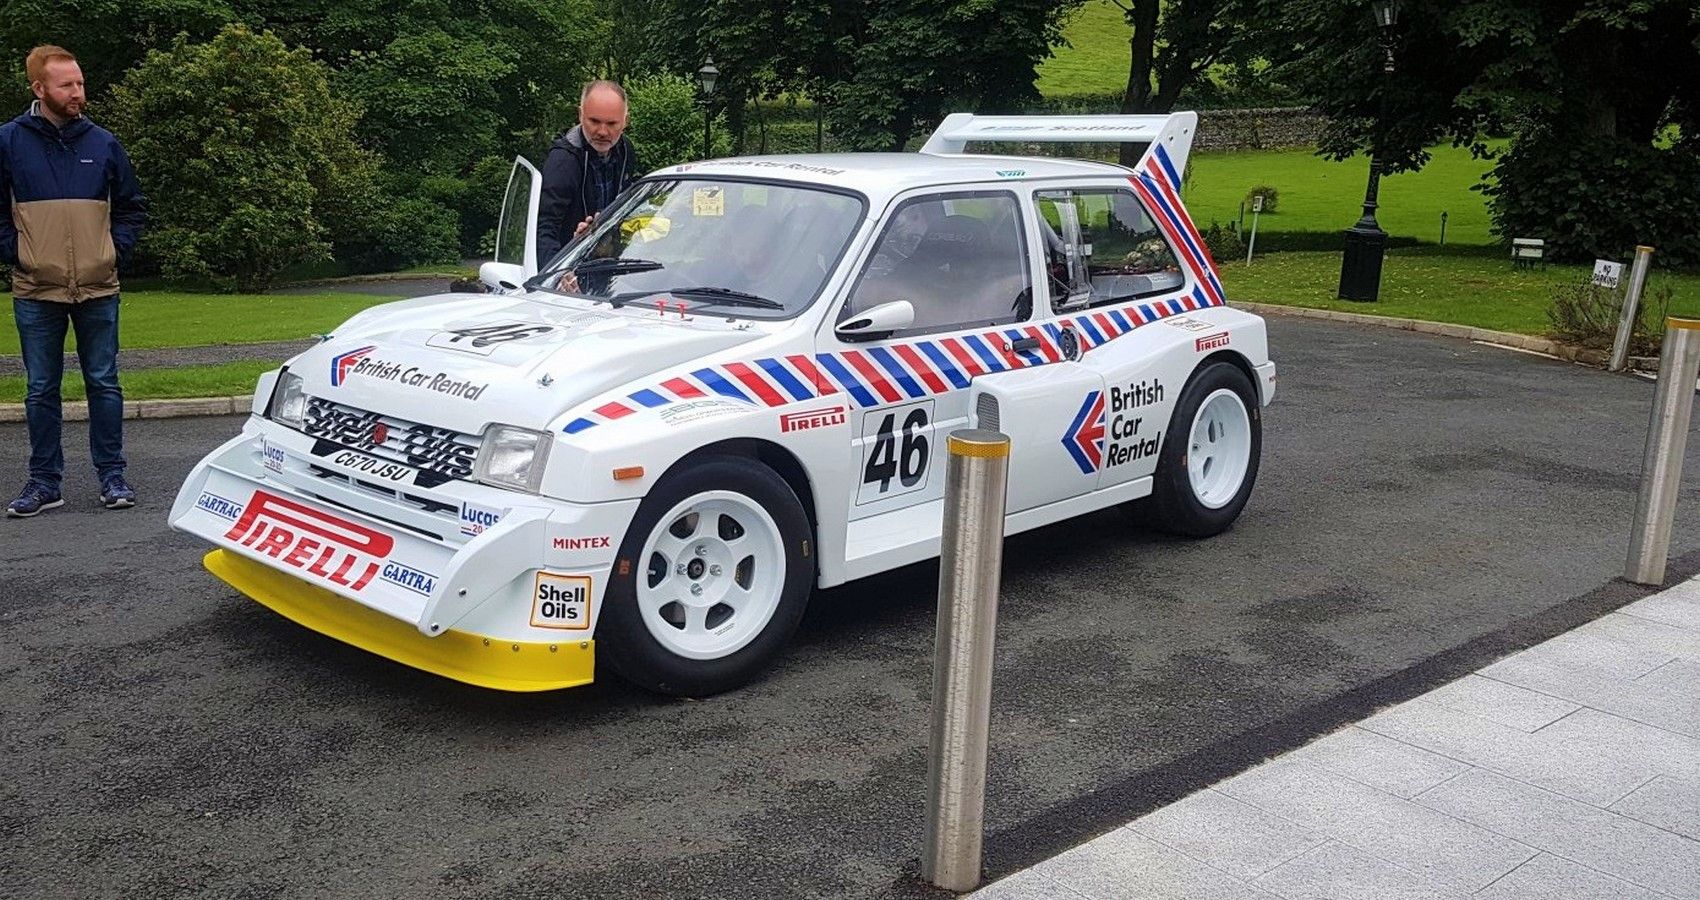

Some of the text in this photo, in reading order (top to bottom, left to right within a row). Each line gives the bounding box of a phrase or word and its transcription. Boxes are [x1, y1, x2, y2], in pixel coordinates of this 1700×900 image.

[448, 323, 554, 348] 46
[1195, 331, 1230, 352] PIRELLI
[353, 357, 489, 401] British Car Rental
[1110, 378, 1164, 413] British
[780, 406, 846, 433] PIRELLI
[1111, 415, 1143, 440] Car
[263, 439, 284, 463] Lucas
[863, 408, 929, 493] 46
[1106, 431, 1161, 469] Rental
[334, 452, 411, 482] C670 JSU
[197, 494, 242, 519] GARTRAC
[224, 489, 394, 592] PIRELLI
[553, 536, 610, 550] MINTEX
[383, 564, 437, 593] GARTRA
[538, 583, 585, 602] Shell
[541, 601, 578, 620] Oils
